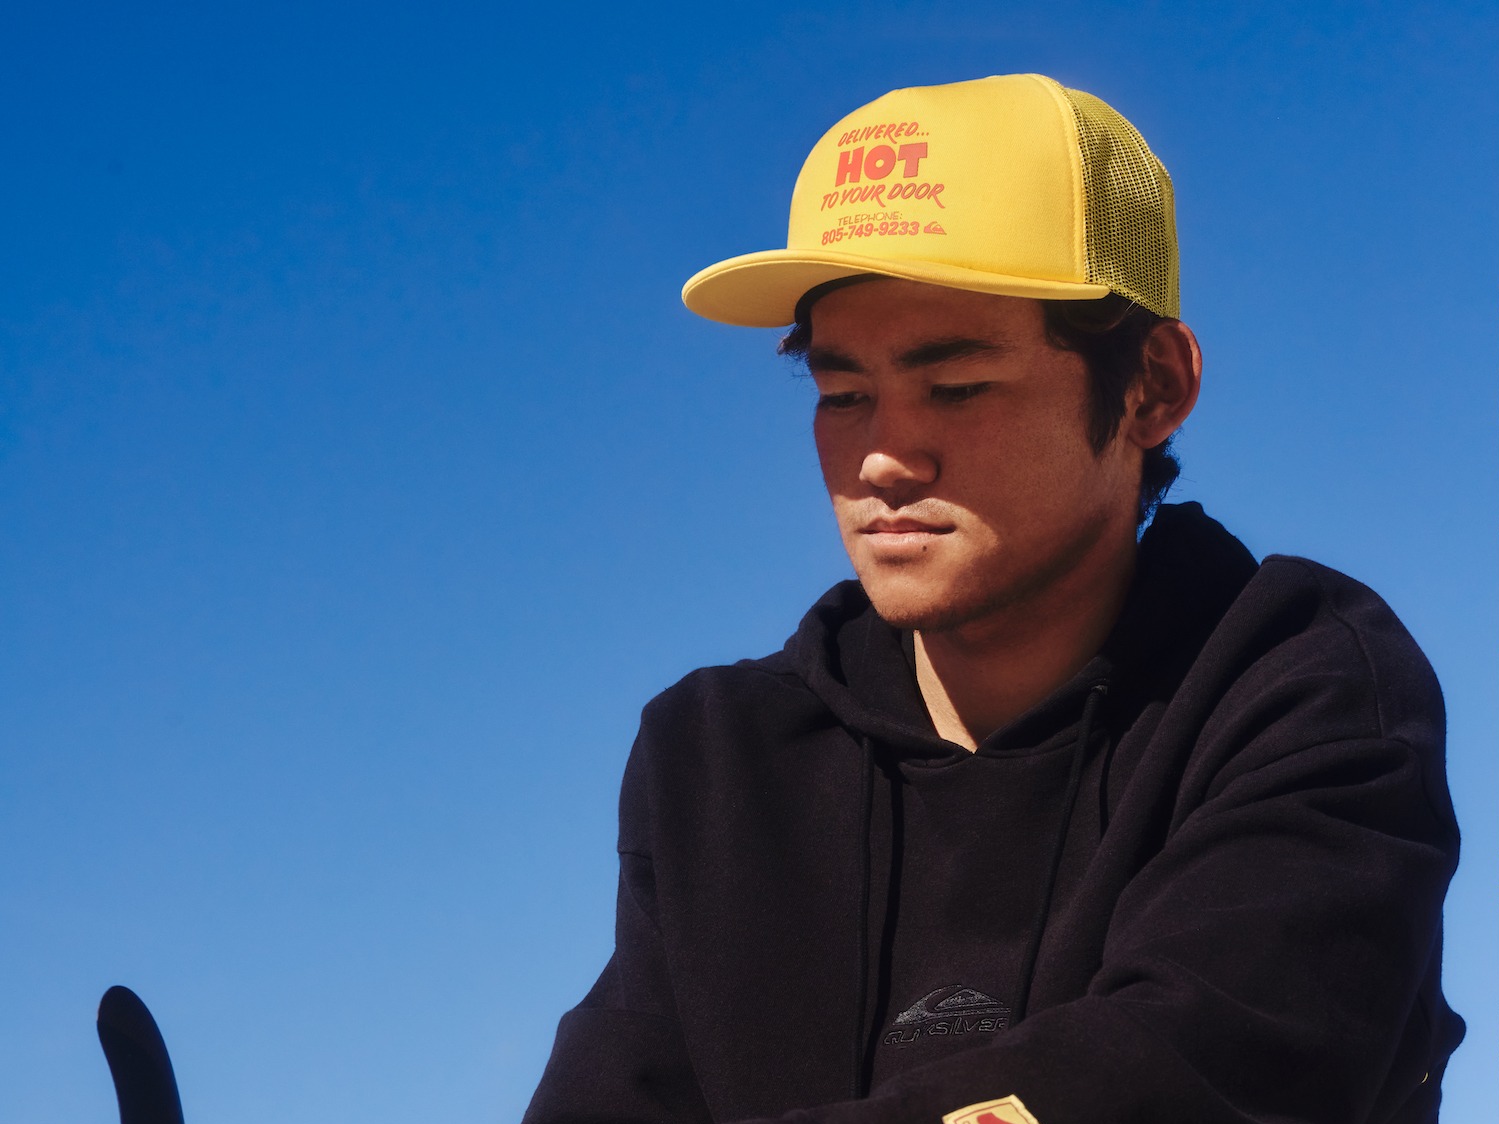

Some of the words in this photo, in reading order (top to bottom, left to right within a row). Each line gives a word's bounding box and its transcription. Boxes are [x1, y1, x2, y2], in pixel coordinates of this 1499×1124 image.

[838, 121, 929, 147] DELIVERED...
[835, 142, 928, 187] HOT
[820, 191, 839, 211] TO
[840, 184, 886, 208] YOUR
[887, 183, 946, 209] DOOR
[838, 211, 903, 226] TELEPHONE:
[821, 221, 920, 246] 805-749-9233
